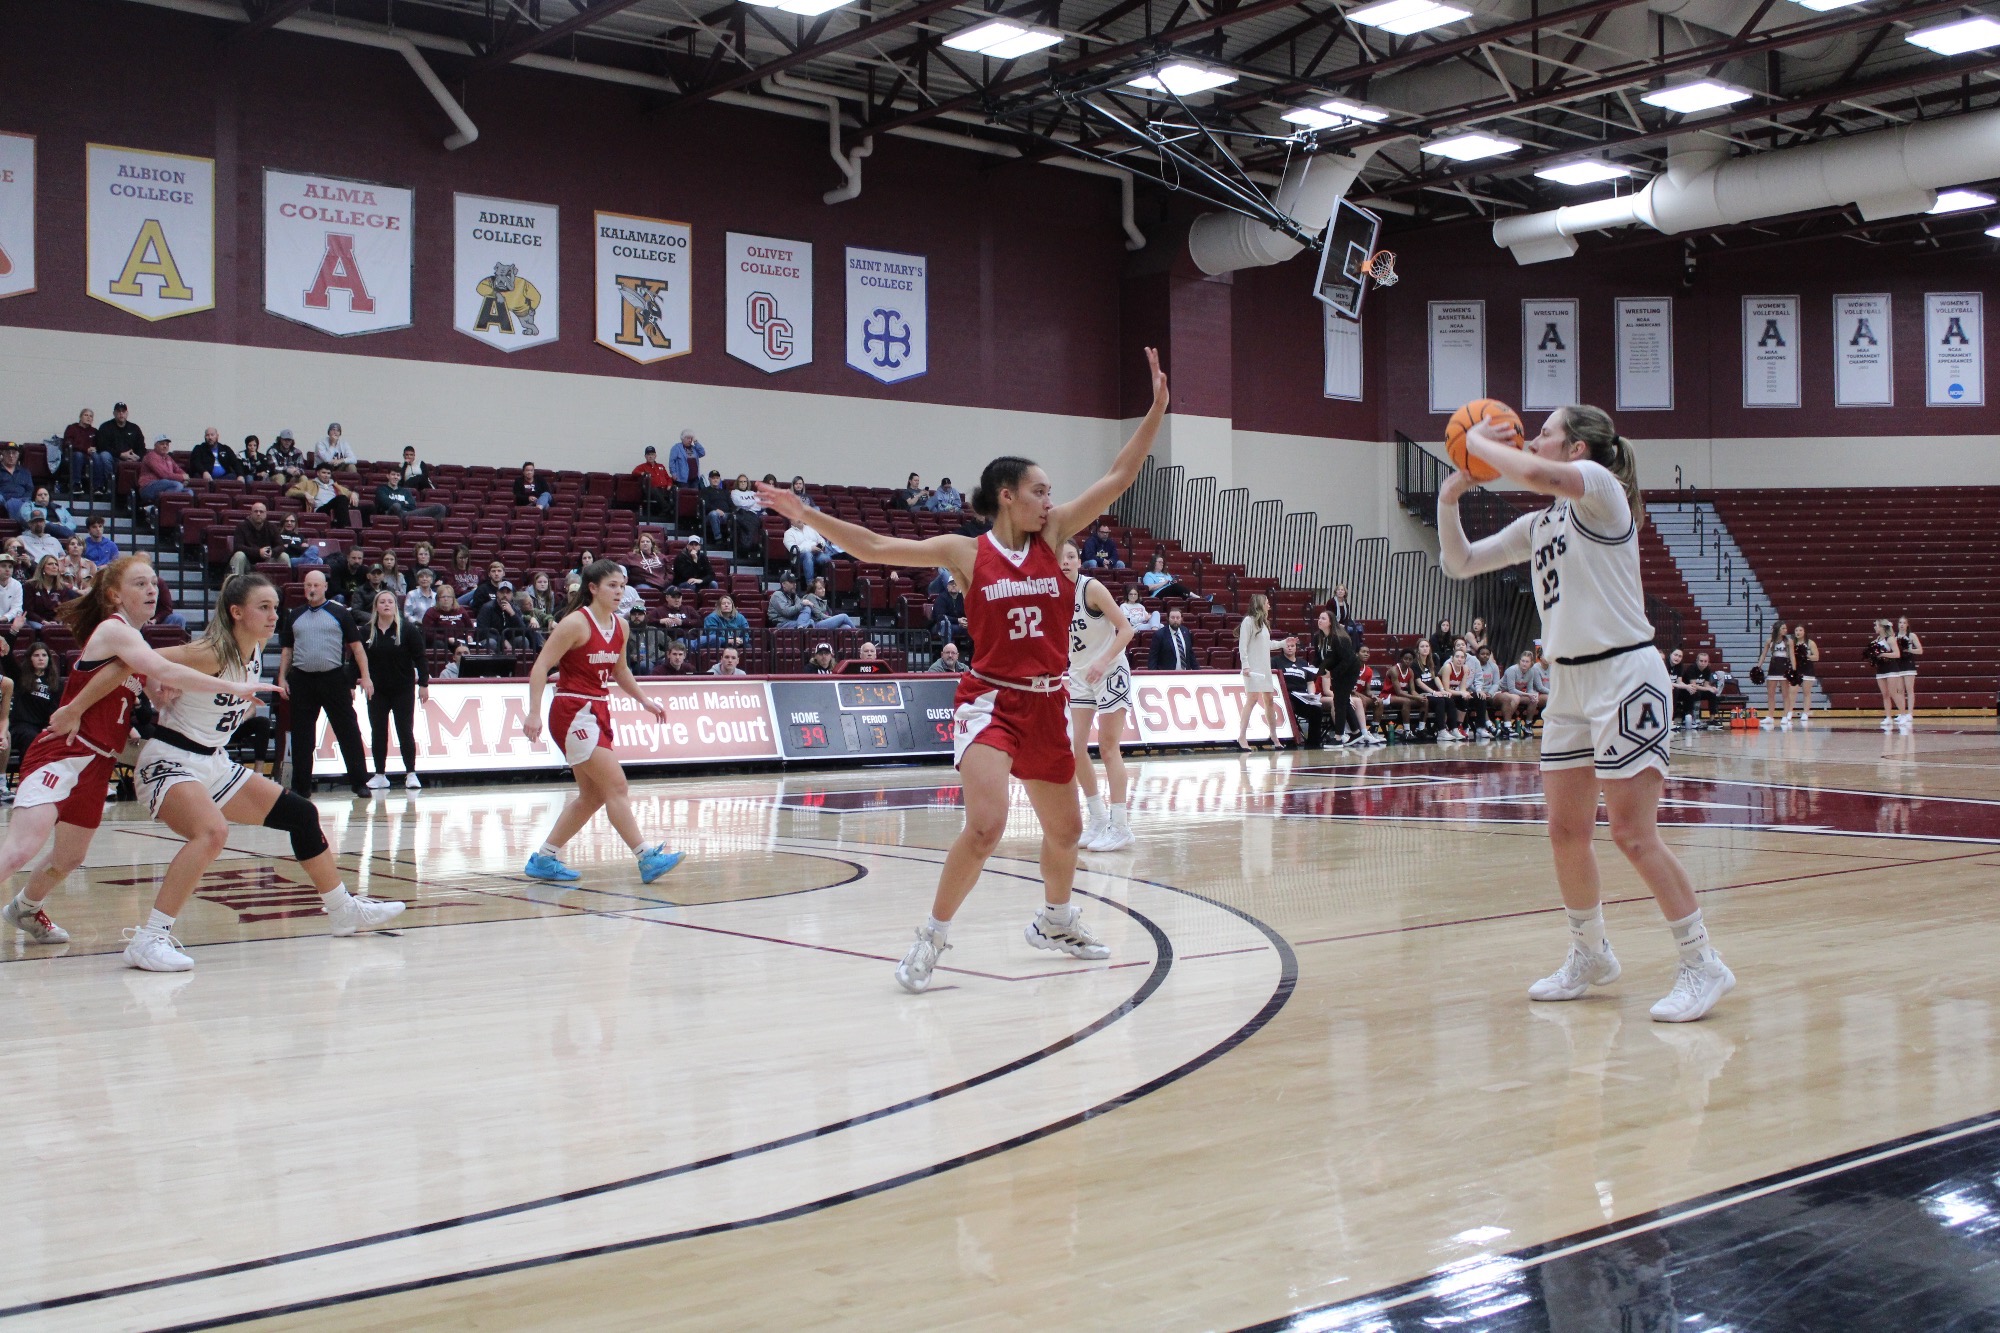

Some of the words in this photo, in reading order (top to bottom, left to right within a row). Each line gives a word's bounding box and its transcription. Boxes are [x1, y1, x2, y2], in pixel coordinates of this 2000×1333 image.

[117, 164, 186, 184] ALBION
[109, 183, 194, 205] COLLEGE
[303, 183, 378, 206] ALMA
[279, 202, 400, 231] COLLEGE
[478, 211, 536, 229] ADRIAN
[472, 228, 542, 247] COLLEGE
[600, 226, 687, 248] KALAMAZOO
[109, 218, 194, 301] A
[612, 245, 676, 264] COLLEGE
[746, 246, 793, 262] OLIVET
[302, 231, 376, 315] A
[740, 261, 800, 279] COLLEGE
[849, 258, 882, 272] SAINT
[883, 262, 923, 278] MARY'S
[860, 275, 913, 292] COLLEGE
[1538, 322, 1566, 351] A
[1758, 319, 1786, 347] A
[1849, 318, 1878, 346] A
[1941, 317, 1969, 345] A
[1534, 534, 1567, 572] COTS
[1006, 605, 1045, 641] 32
[859, 665, 872, 673] POSS
[1115, 675, 1126, 689] A
[668, 693, 700, 711] and
[703, 690, 762, 710] Marion
[853, 684, 897, 705] 3:42
[790, 711, 821, 724] HOME
[861, 714, 889, 725] PERIOD
[926, 708, 955, 720] GUEST
[1636, 702, 1660, 731] A
[696, 715, 770, 745] Court
[800, 725, 826, 747] 39
[873, 727, 885, 747] 3
